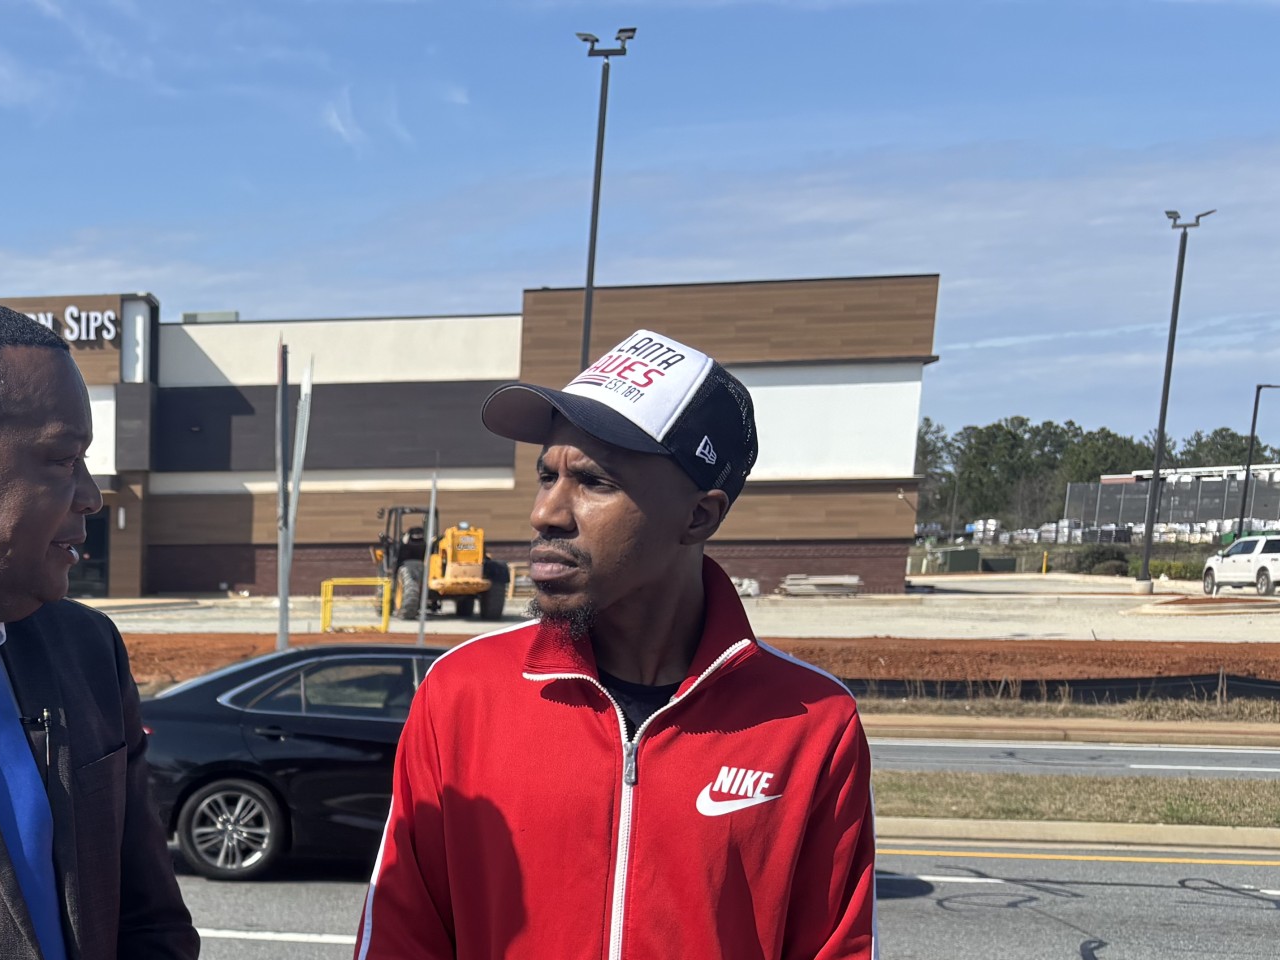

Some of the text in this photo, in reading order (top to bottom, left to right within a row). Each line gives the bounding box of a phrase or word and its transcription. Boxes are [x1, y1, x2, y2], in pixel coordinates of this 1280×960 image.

[64, 305, 117, 341] SIPS
[604, 379, 646, 404] EST. 1871
[712, 766, 774, 798] NIKE
